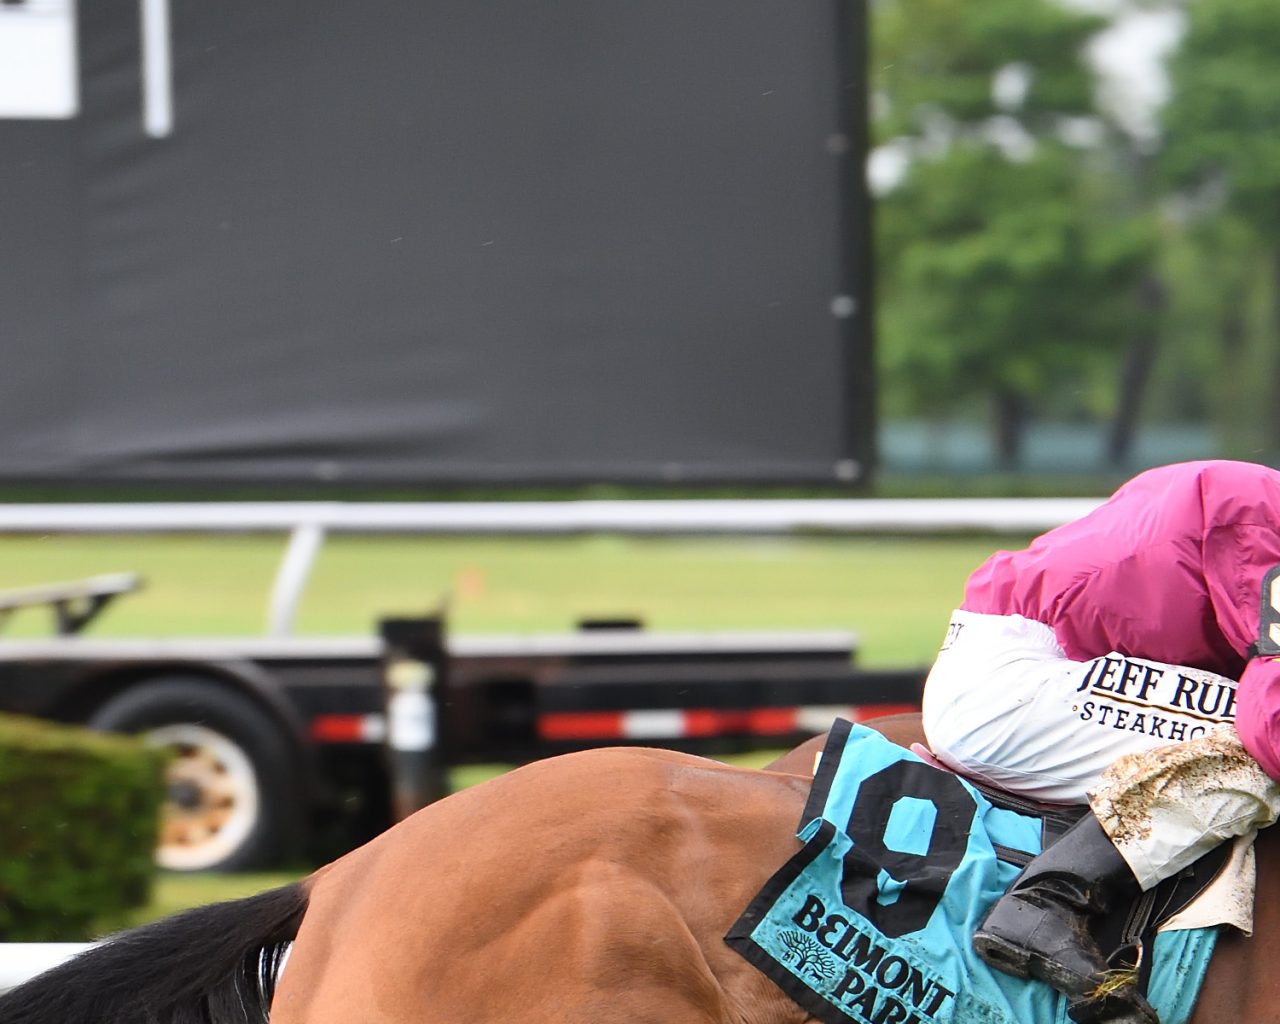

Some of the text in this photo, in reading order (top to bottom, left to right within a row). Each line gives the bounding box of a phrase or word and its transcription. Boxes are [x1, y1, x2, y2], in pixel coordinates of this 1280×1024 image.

[1076, 656, 1165, 701] JEFF
[840, 759, 977, 939] 9
[792, 894, 955, 1019] BELMONT
